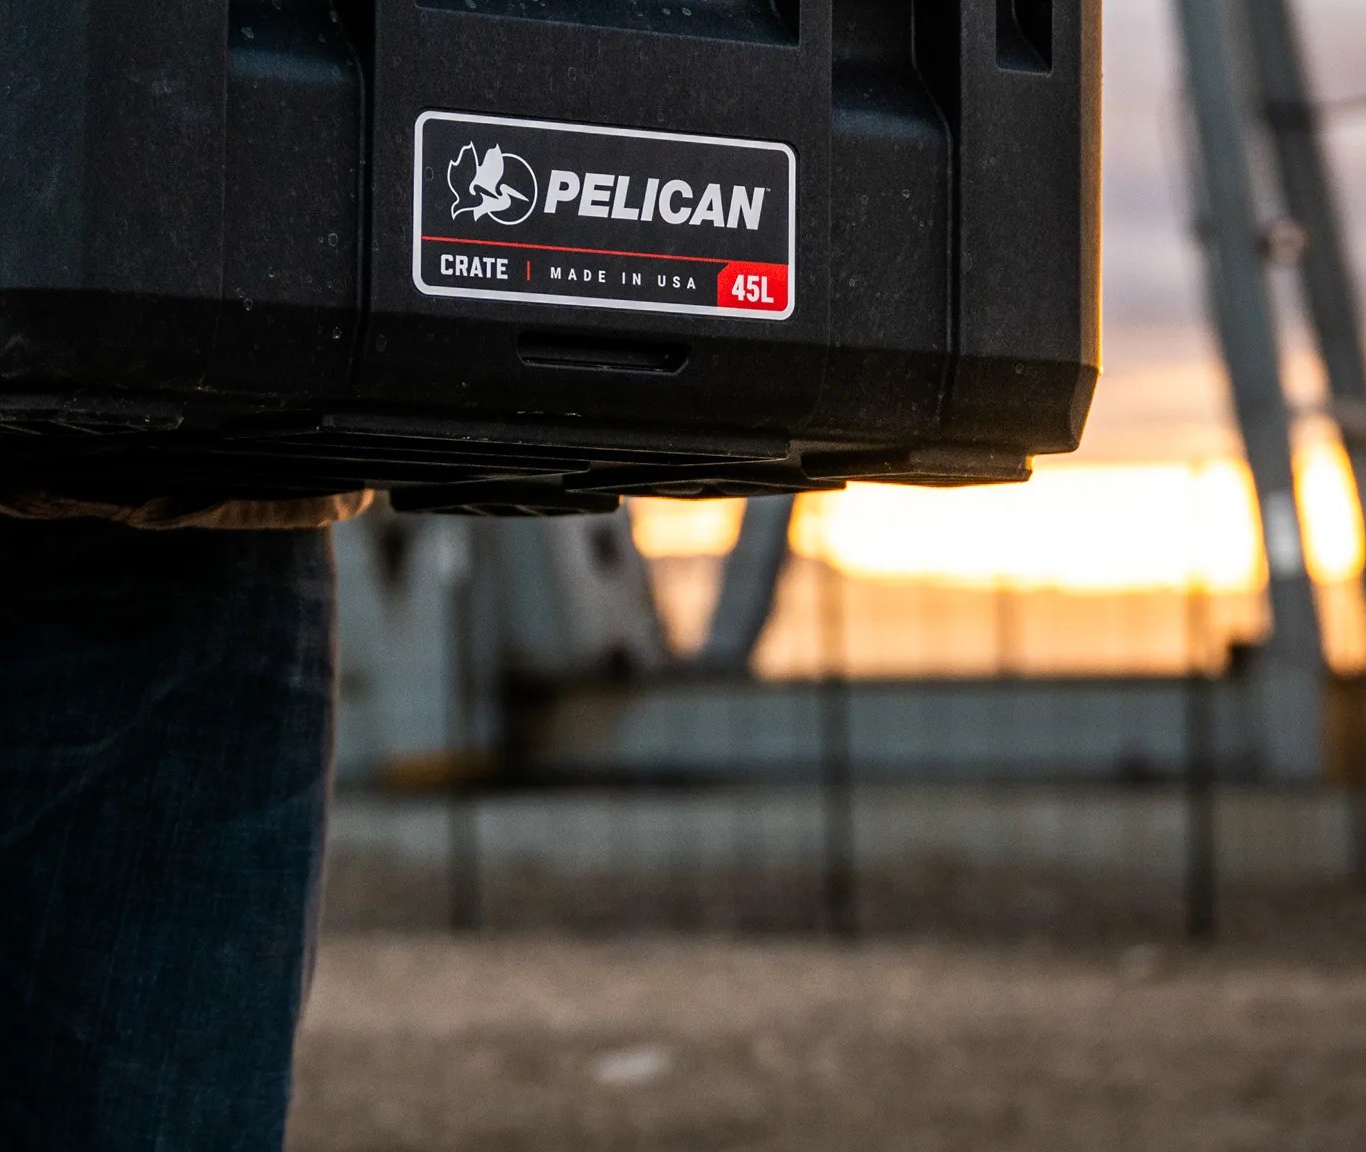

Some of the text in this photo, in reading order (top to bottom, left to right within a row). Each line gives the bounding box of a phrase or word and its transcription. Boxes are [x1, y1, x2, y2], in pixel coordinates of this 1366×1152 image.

[544, 170, 765, 230] PELICAN
[441, 254, 695, 289] CRATE MADE IN USA
[731, 274, 774, 304] 45L
